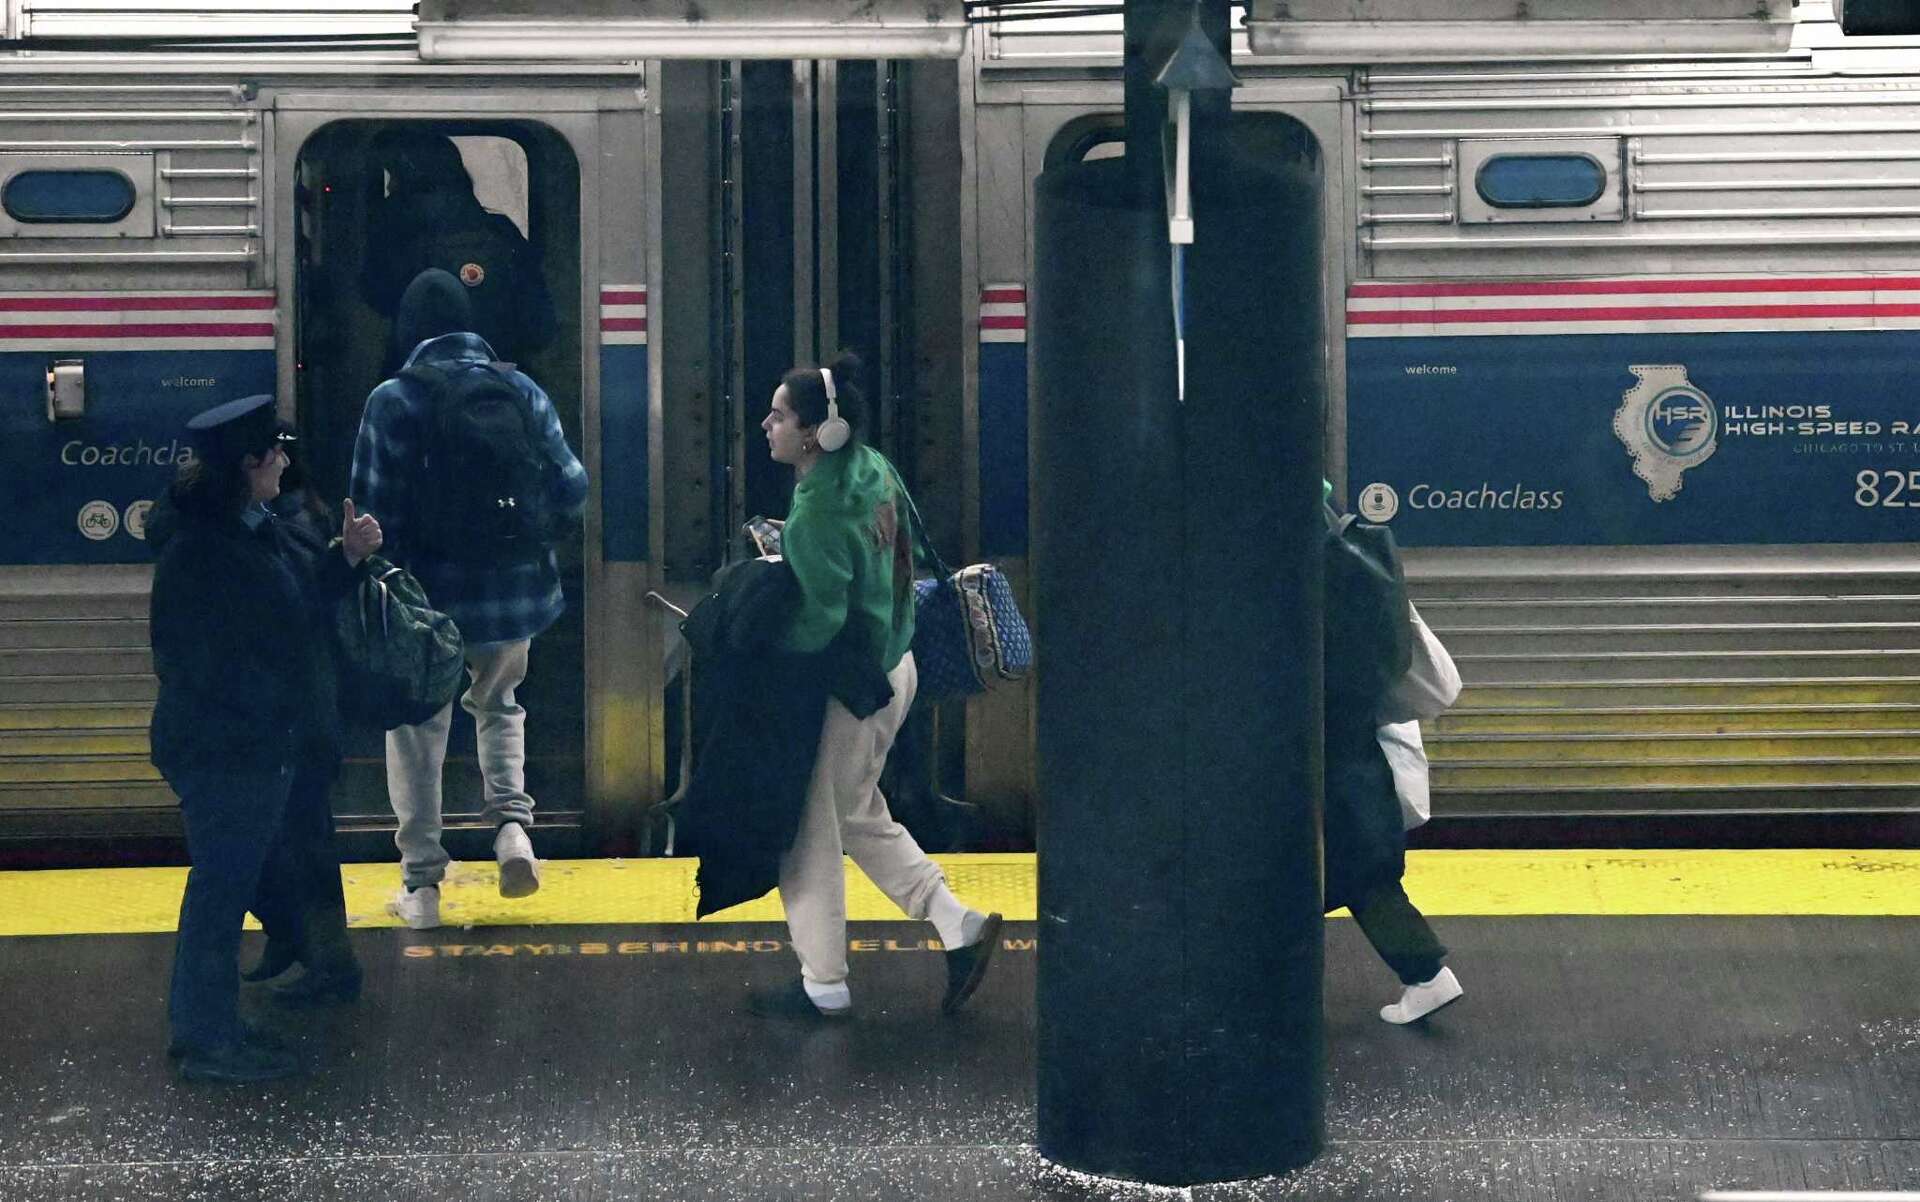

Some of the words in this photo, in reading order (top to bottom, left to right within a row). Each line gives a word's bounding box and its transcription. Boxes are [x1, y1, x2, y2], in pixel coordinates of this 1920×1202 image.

[1405, 363, 1457, 375] welcome
[161, 376, 216, 387] welcome
[1653, 400, 1708, 426] HSR
[1724, 404, 1832, 419] ILLINOIS
[1724, 421, 1882, 436] HIGH-SPEED
[60, 438, 195, 466] Coachcla
[1408, 482, 1564, 510] Coachclass
